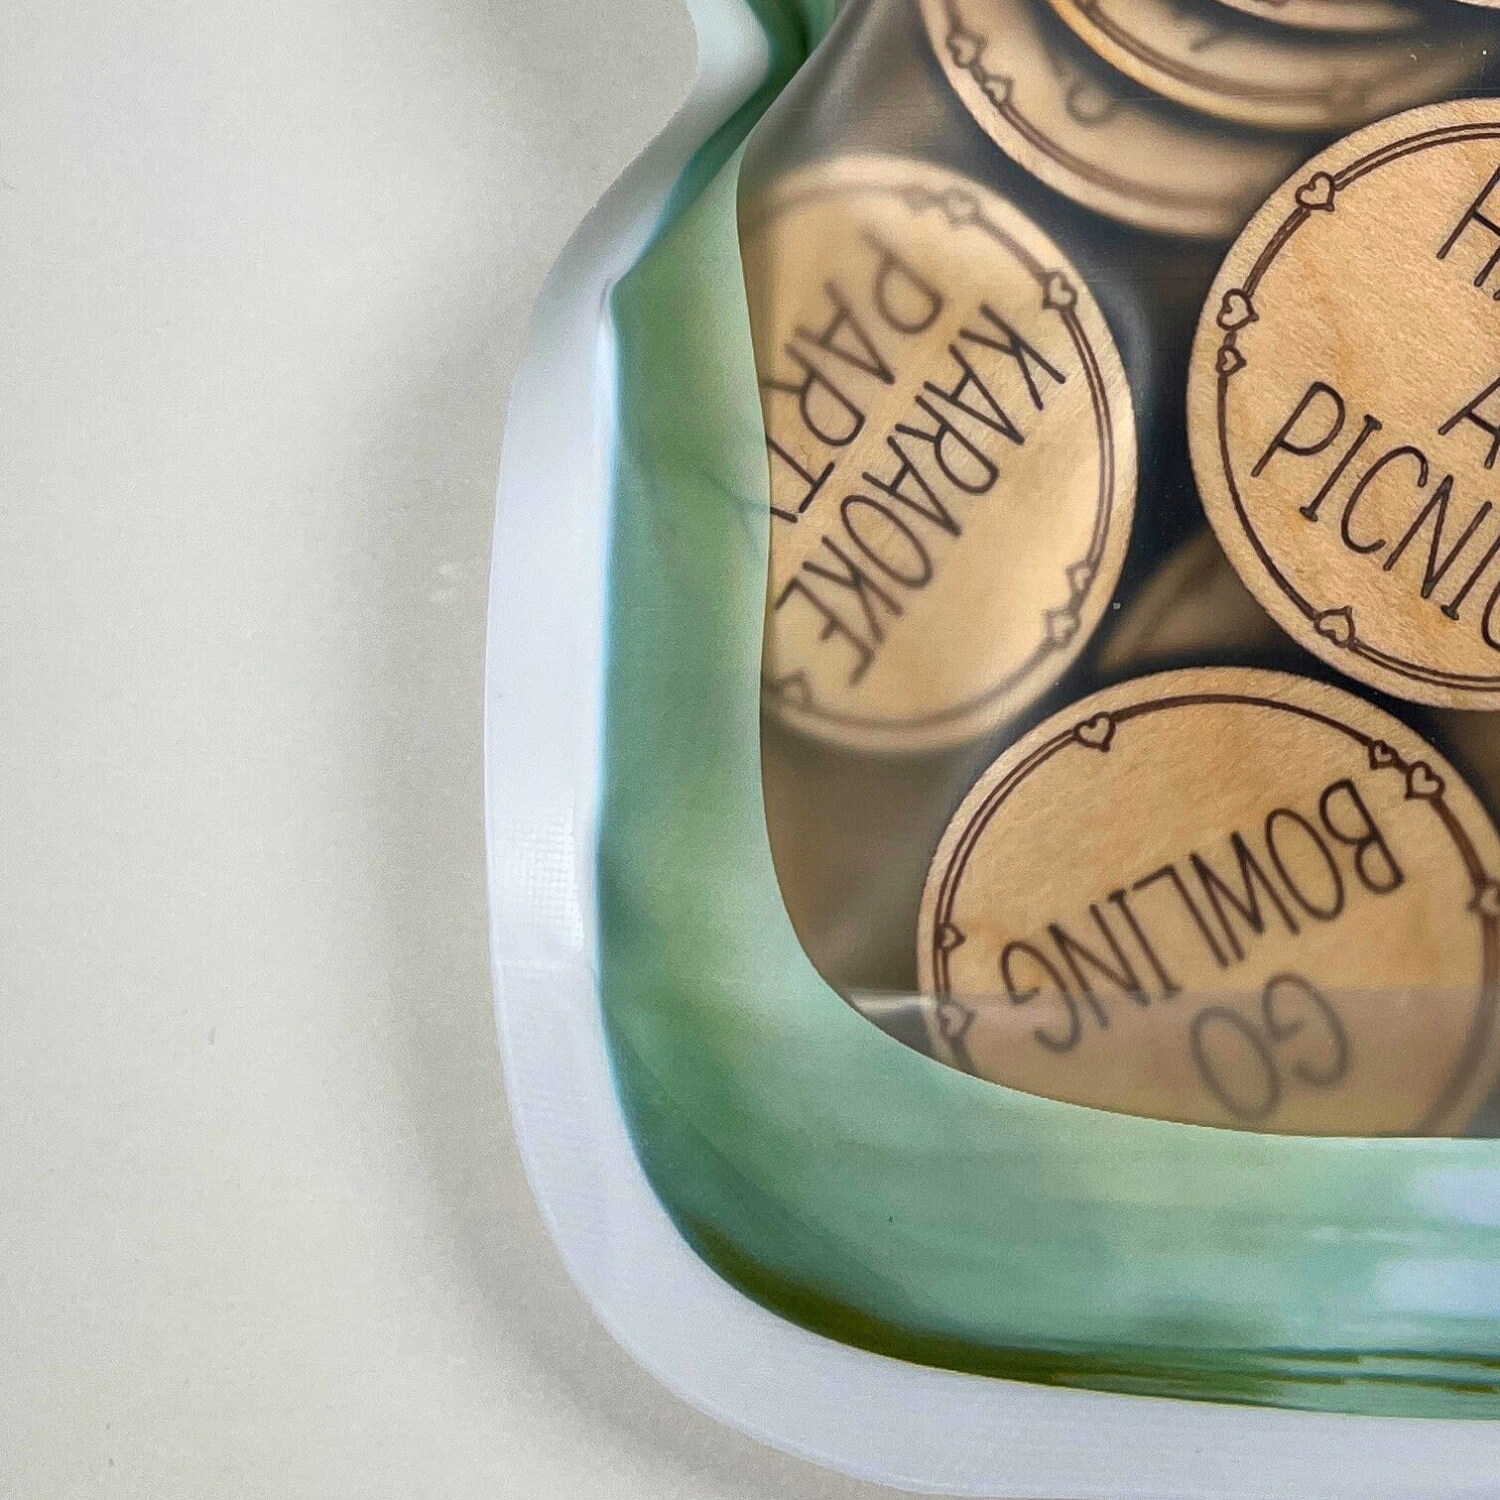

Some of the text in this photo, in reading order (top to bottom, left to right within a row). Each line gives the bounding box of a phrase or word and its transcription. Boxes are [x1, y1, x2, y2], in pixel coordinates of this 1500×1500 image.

[774, 303, 1067, 687] KARAOKE
[999, 777, 1405, 1055] BOWLING
[1188, 971, 1350, 1122] GO
